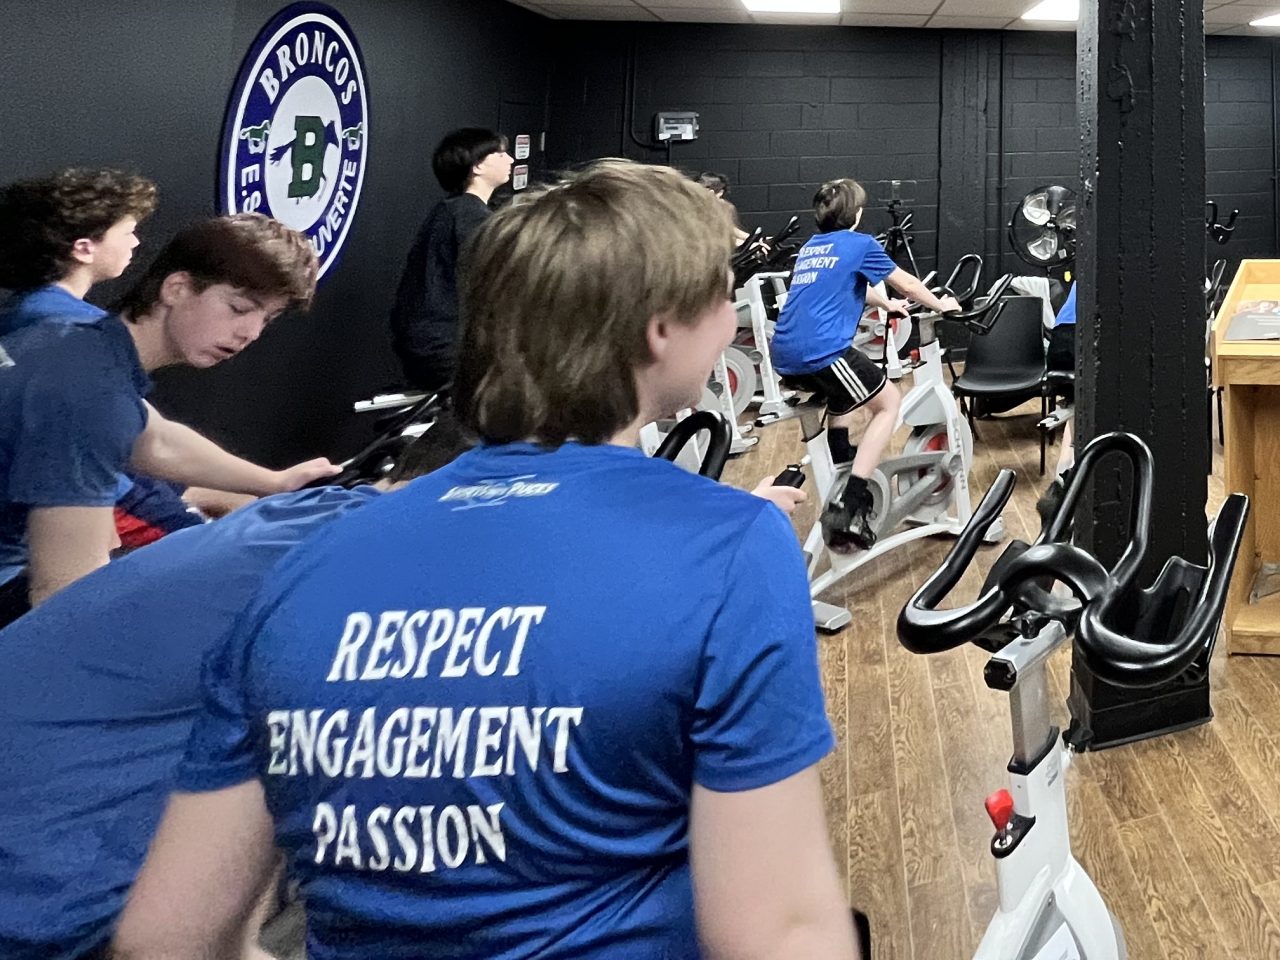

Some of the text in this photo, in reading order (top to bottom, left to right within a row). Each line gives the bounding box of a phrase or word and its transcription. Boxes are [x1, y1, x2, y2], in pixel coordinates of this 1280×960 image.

[259, 30, 357, 105] BRONCOS
[287, 115, 328, 199] B
[308, 158, 357, 258] UVERTE
[325, 605, 547, 682] RESPECT
[266, 705, 585, 779] ENGAGEMENT
[312, 800, 507, 874] PASSION
